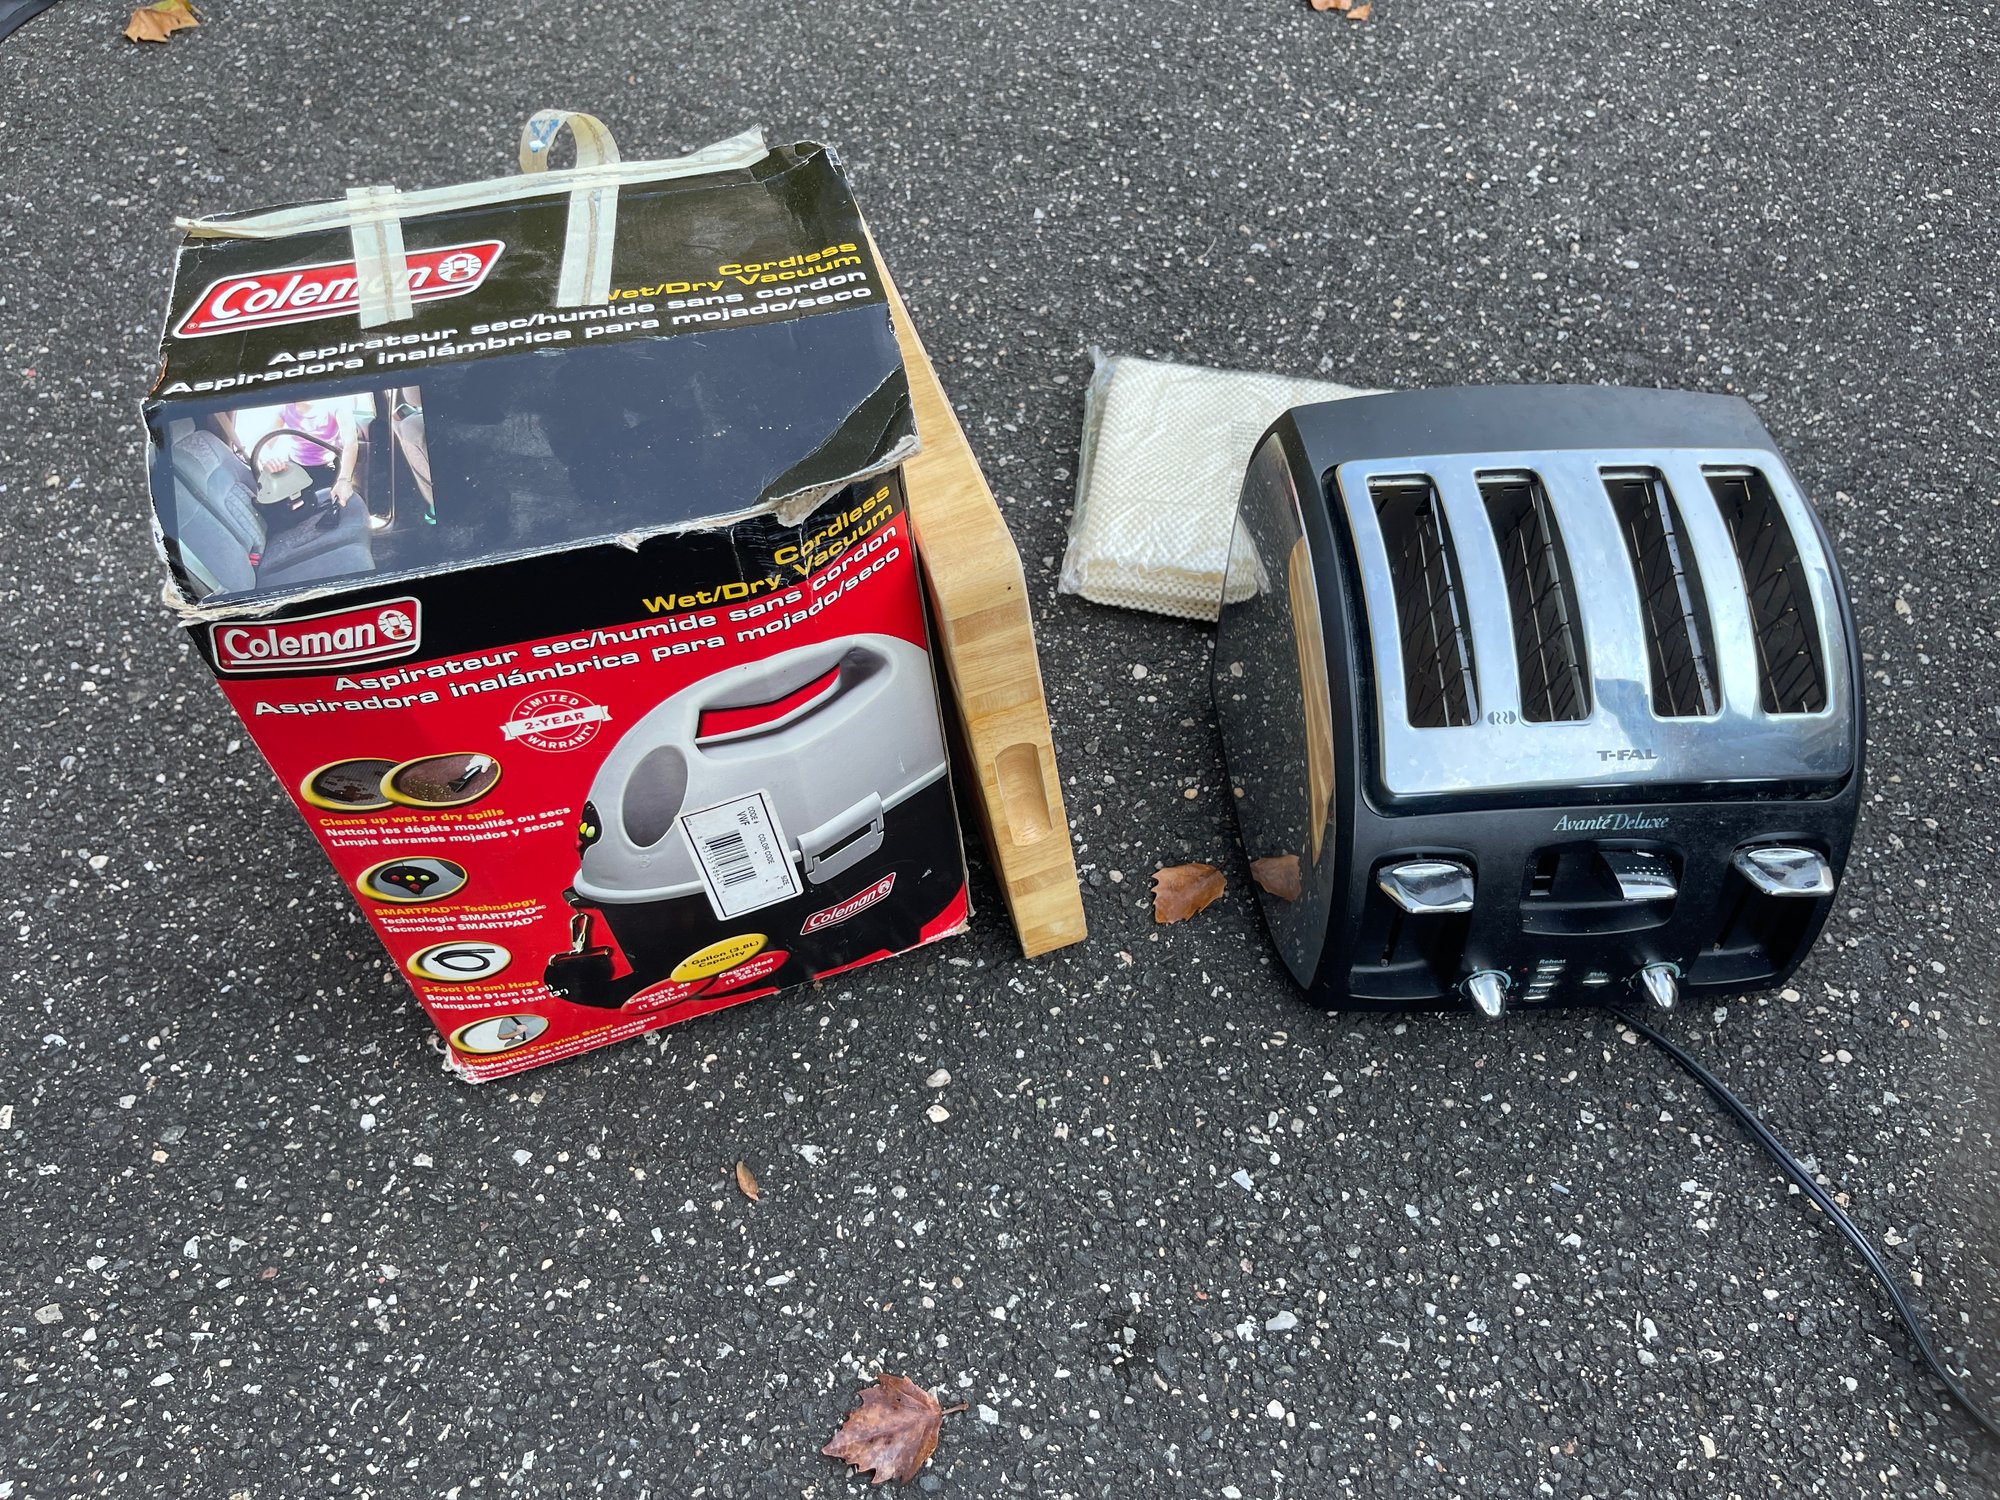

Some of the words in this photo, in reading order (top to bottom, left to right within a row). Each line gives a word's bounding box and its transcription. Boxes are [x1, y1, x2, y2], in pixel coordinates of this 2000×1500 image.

[719, 243, 858, 276] Cordless
[734, 254, 861, 286] Vacuum
[268, 328, 458, 366] Aspirateur
[471, 302, 655, 335] sec/humide
[667, 291, 744, 309] sans
[756, 270, 867, 299] cordon
[163, 357, 363, 395] Aspiradora
[378, 328, 572, 365] inalámbrica
[584, 318, 660, 339] para
[672, 286, 872, 325] mojado/seco
[773, 485, 891, 566] Cordless
[642, 573, 783, 613] Wet/Dry
[793, 503, 893, 577] Vacuum
[335, 649, 520, 692] Aspirateur
[530, 611, 717, 659] sec/humide
[728, 591, 804, 622] sans
[812, 525, 898, 593] cordon
[224, 623, 376, 660] Coleman
[254, 688, 440, 717] Aspiradora
[448, 650, 641, 698] inalámbrica
[652, 635, 726, 663] para
[737, 547, 900, 644] mojado/seco
[519, 694, 579, 716] LIMITED
[524, 711, 586, 731] 2-YEAR
[527, 724, 594, 749] WARRANTY
[1596, 748, 1658, 762] T-FAL
[320, 818, 367, 827] Cleans
[370, 817, 388, 825] up
[391, 815, 419, 824] wet
[440, 813, 463, 822] dry
[466, 808, 505, 821] spills
[325, 826, 378, 837] Nettoie
[380, 826, 401, 835] les
[404, 824, 451, 835] dégâts
[454, 818, 514, 831] mouillés
[517, 814, 536, 823] ou
[538, 807, 571, 819] secs
[737, 811, 751, 826] VWF
[1553, 813, 1614, 832] Avanté
[1612, 812, 1669, 831] Deluxe
[331, 838, 379, 847] Limpia
[382, 836, 446, 845] derrames
[449, 831, 509, 843] mojados
[511, 828, 520, 837] y
[523, 820, 564, 833] secos
[461, 898, 537, 913] Technology
[810, 892, 876, 928] Coleman
[379, 916, 457, 925] Technologie
[384, 923, 455, 933] Tecnología
[691, 951, 727, 965] Gallon
[698, 950, 746, 968] Capacity
[421, 986, 462, 994] 3-Foot
[464, 983, 506, 993] (91cm)
[508, 980, 540, 989] Hose
[426, 993, 464, 1002] Boyau
[466, 993, 482, 1001] de
[484, 991, 519, 999] 91cm
[627, 986, 675, 1004] Capacité
[677, 981, 691, 990] de
[430, 1001, 491, 1011] Manguera
[493, 999, 509, 1007] de
[511, 994, 546, 1005] 91cm
[463, 1050, 531, 1065] Convenient
[530, 1034, 580, 1052] Carrying
[582, 1022, 613, 1036] Strap
[511, 1047, 580, 1070] conveniente
[583, 1036, 608, 1049] para
[611, 1023, 647, 1039] cargar
[538, 1048, 552, 1057] de
[554, 1031, 608, 1052] transport
[610, 1015, 657, 1034] pratique
